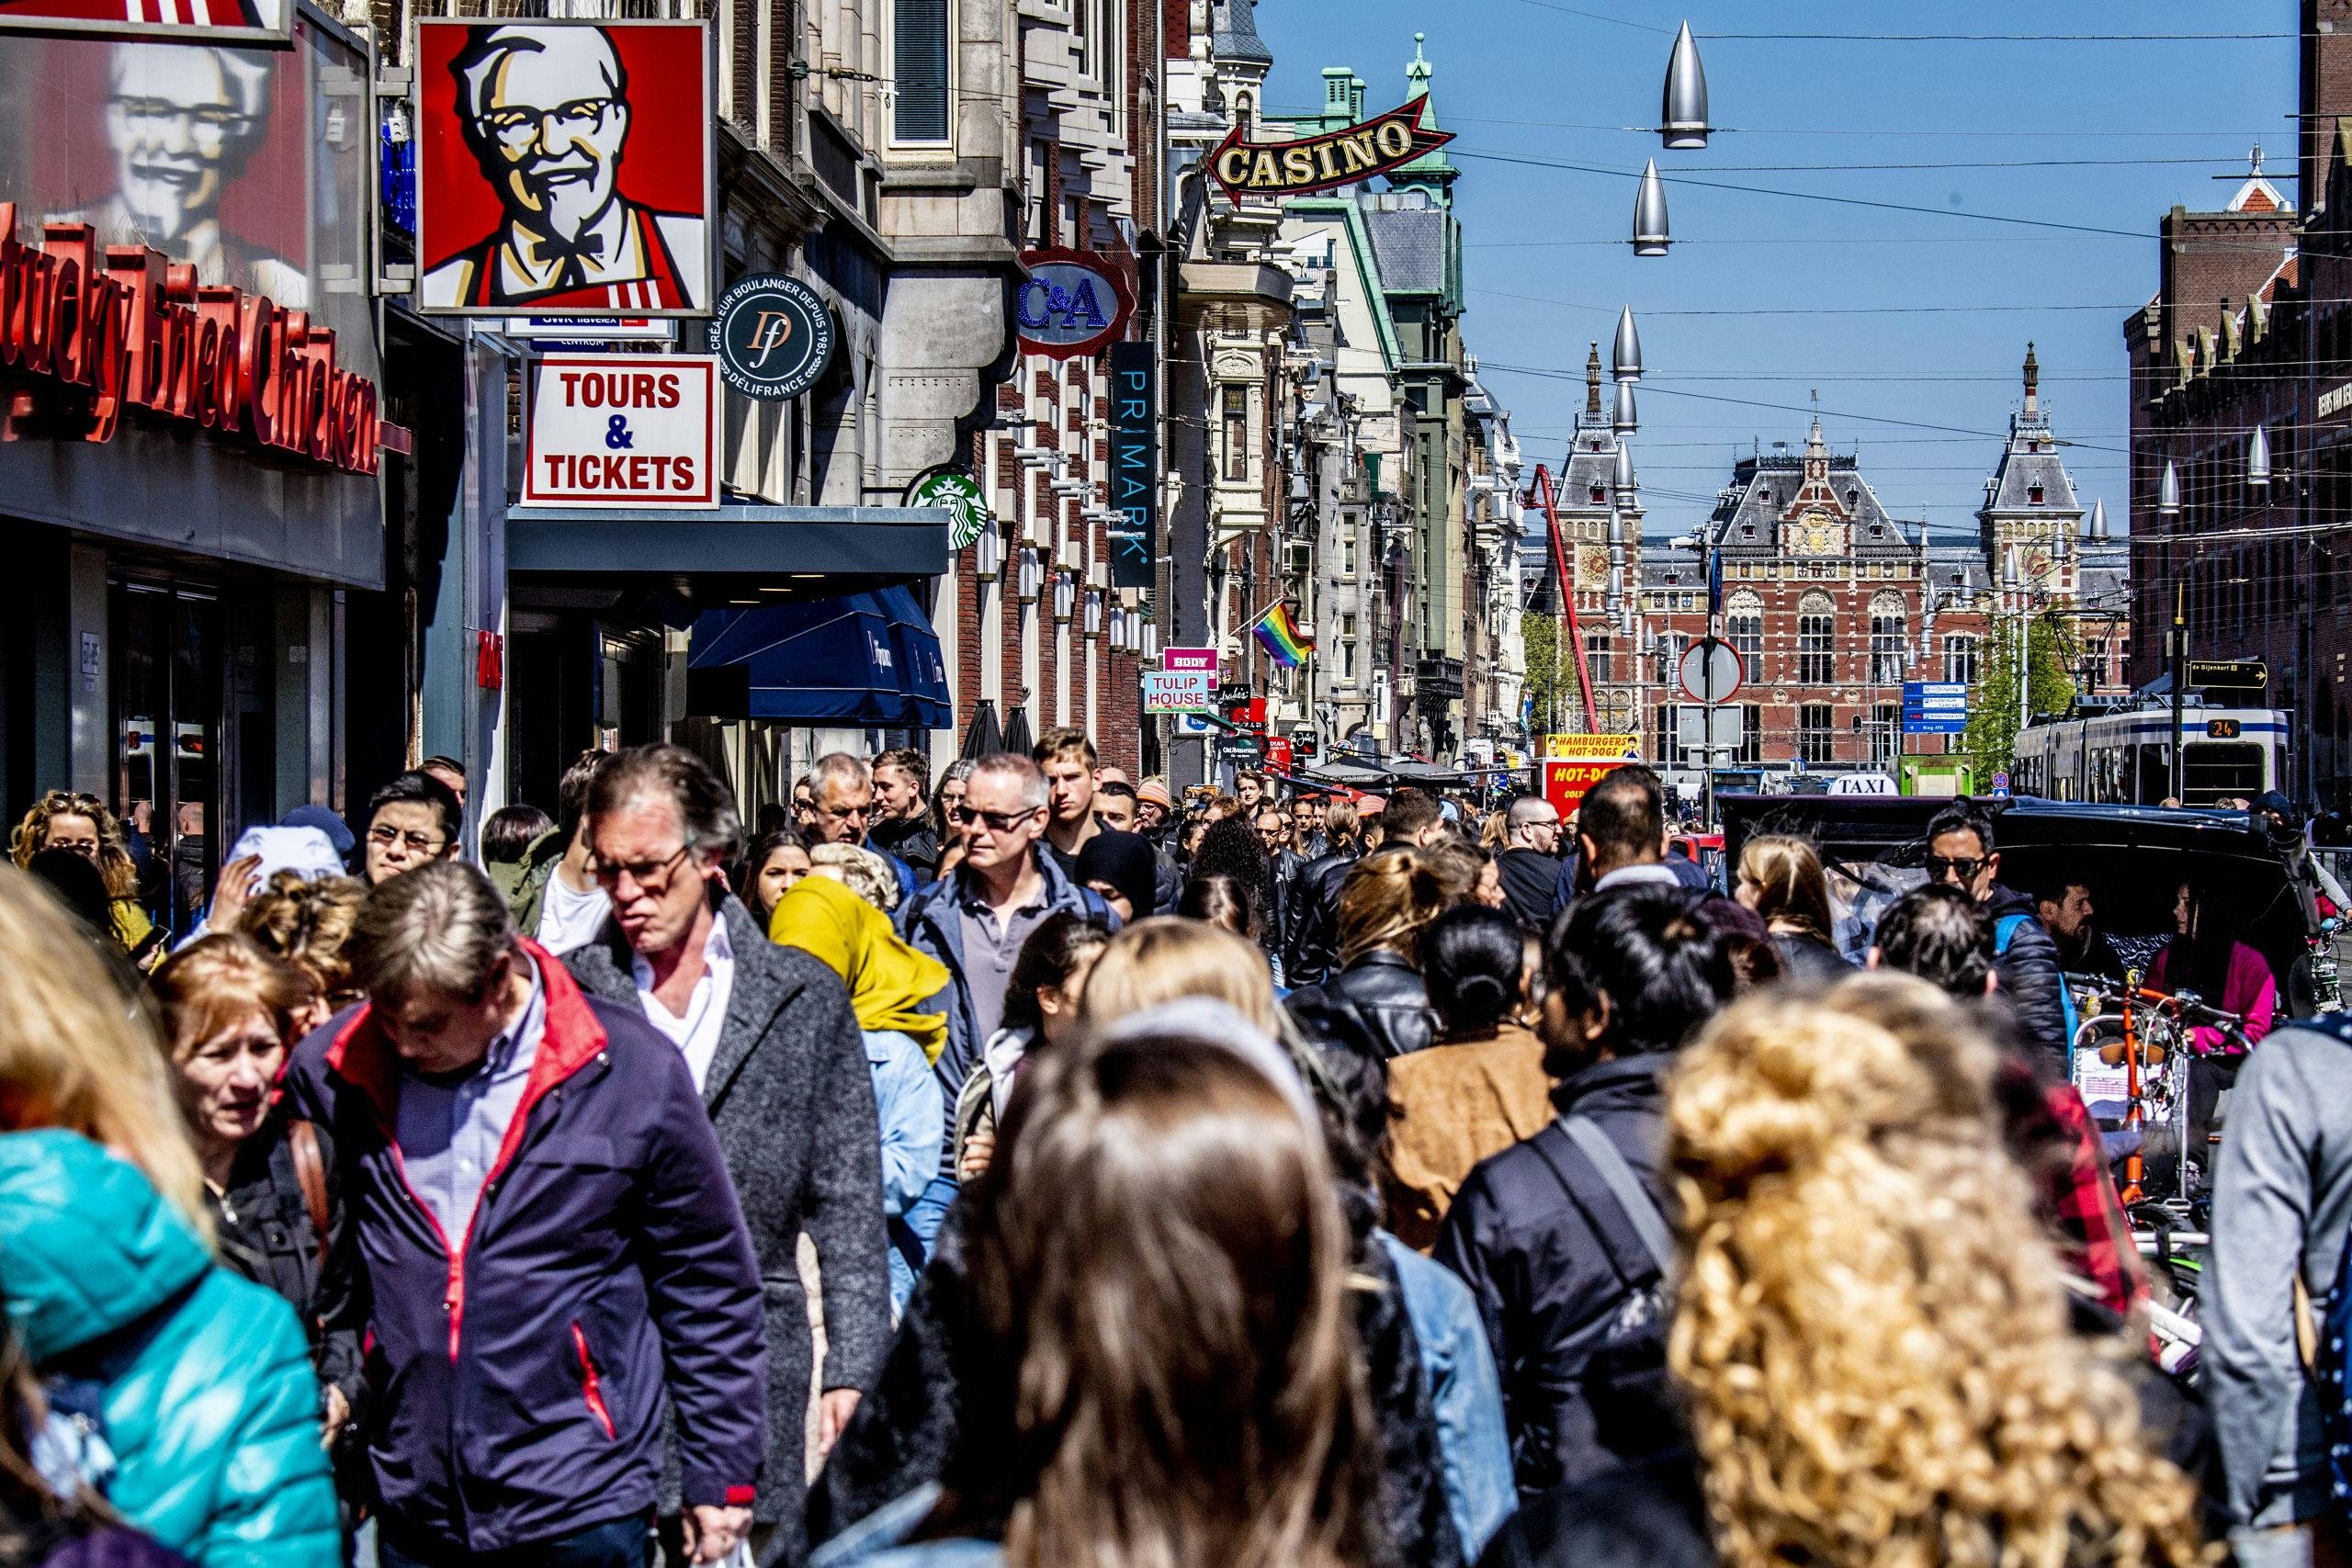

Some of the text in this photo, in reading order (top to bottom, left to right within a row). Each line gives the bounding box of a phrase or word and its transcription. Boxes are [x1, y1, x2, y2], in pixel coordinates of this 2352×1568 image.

[1218, 119, 1412, 186] CASINO
[1018, 277, 1108, 327] C&A
[732, 278, 800, 299] BOULANGER
[798, 291, 826, 329] DEPUIS
[816, 331, 827, 355] 1983
[107, 244, 242, 432] Fried
[243, 295, 379, 476] Chicken
[560, 373, 680, 409] TOURS
[729, 372, 807, 396] DÉLIFRANCE
[605, 414, 634, 449] &
[544, 455, 695, 491] TICKETS
[1120, 370, 1147, 557] PRIMARK
[1173, 657, 1209, 668] BODY
[1153, 677, 1198, 689] TULIP
[1149, 693, 1204, 705] HOUSE
[2213, 721, 2233, 736] 24
[1559, 737, 1627, 746] HAMBURGERS
[1568, 747, 1618, 756] HOT-DOGS
[1555, 768, 1610, 782] HOT-D
[1839, 779, 1885, 794] TAXI
